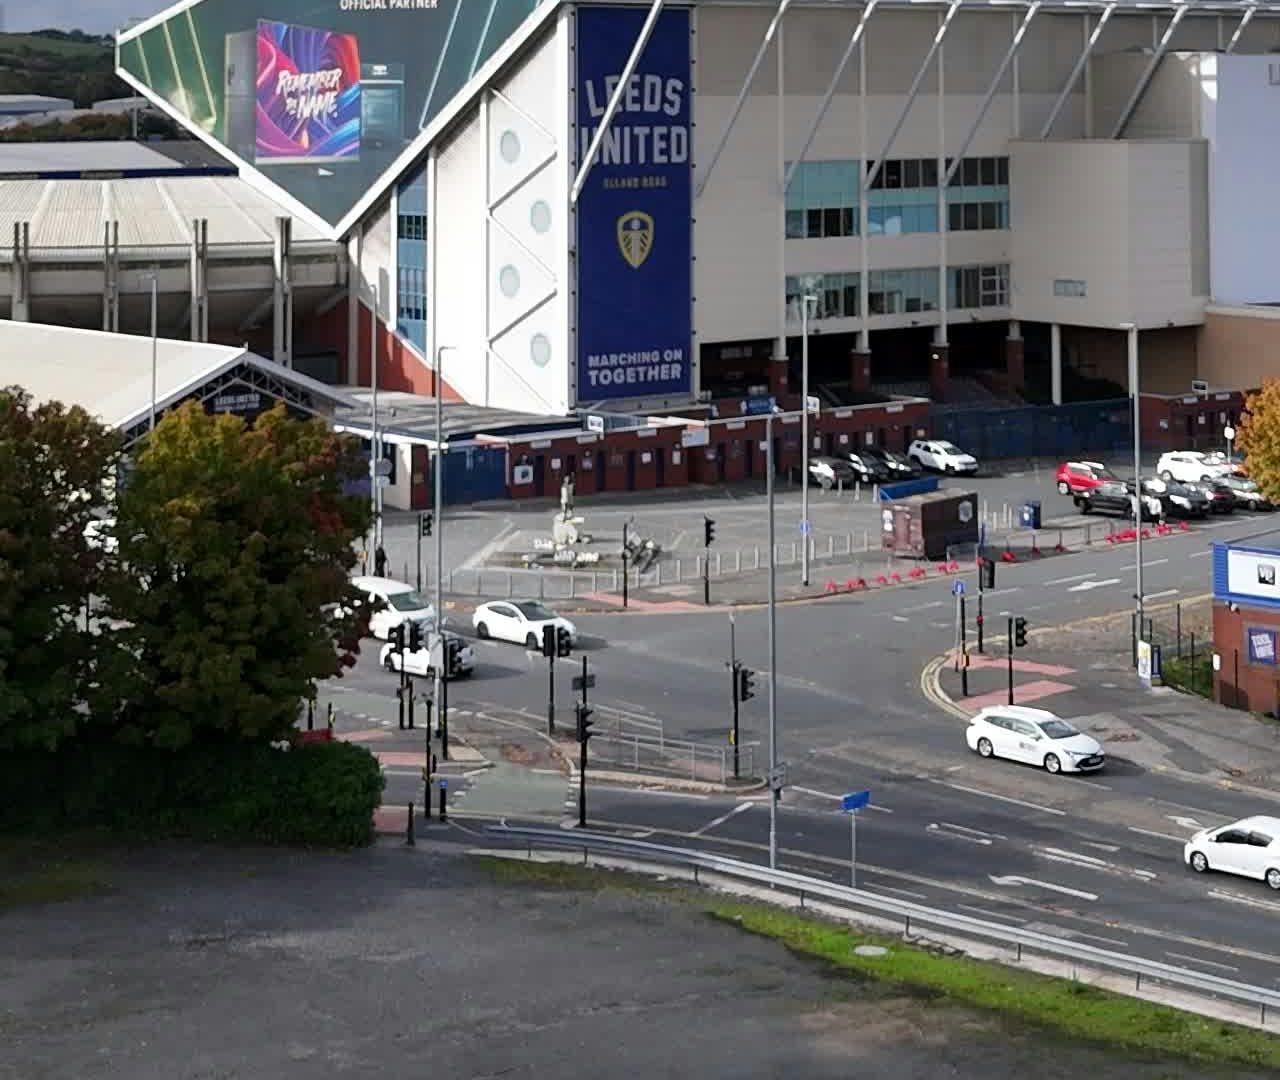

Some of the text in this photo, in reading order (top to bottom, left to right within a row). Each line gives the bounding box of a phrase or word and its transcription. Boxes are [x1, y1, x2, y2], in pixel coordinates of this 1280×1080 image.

[276, 67, 342, 97] REMEMBER
[585, 73, 684, 117] LEEDS
[581, 125, 689, 165] UNITED
[588, 349, 683, 368] MARCHING ON
[588, 363, 682, 386] TOGETHER
